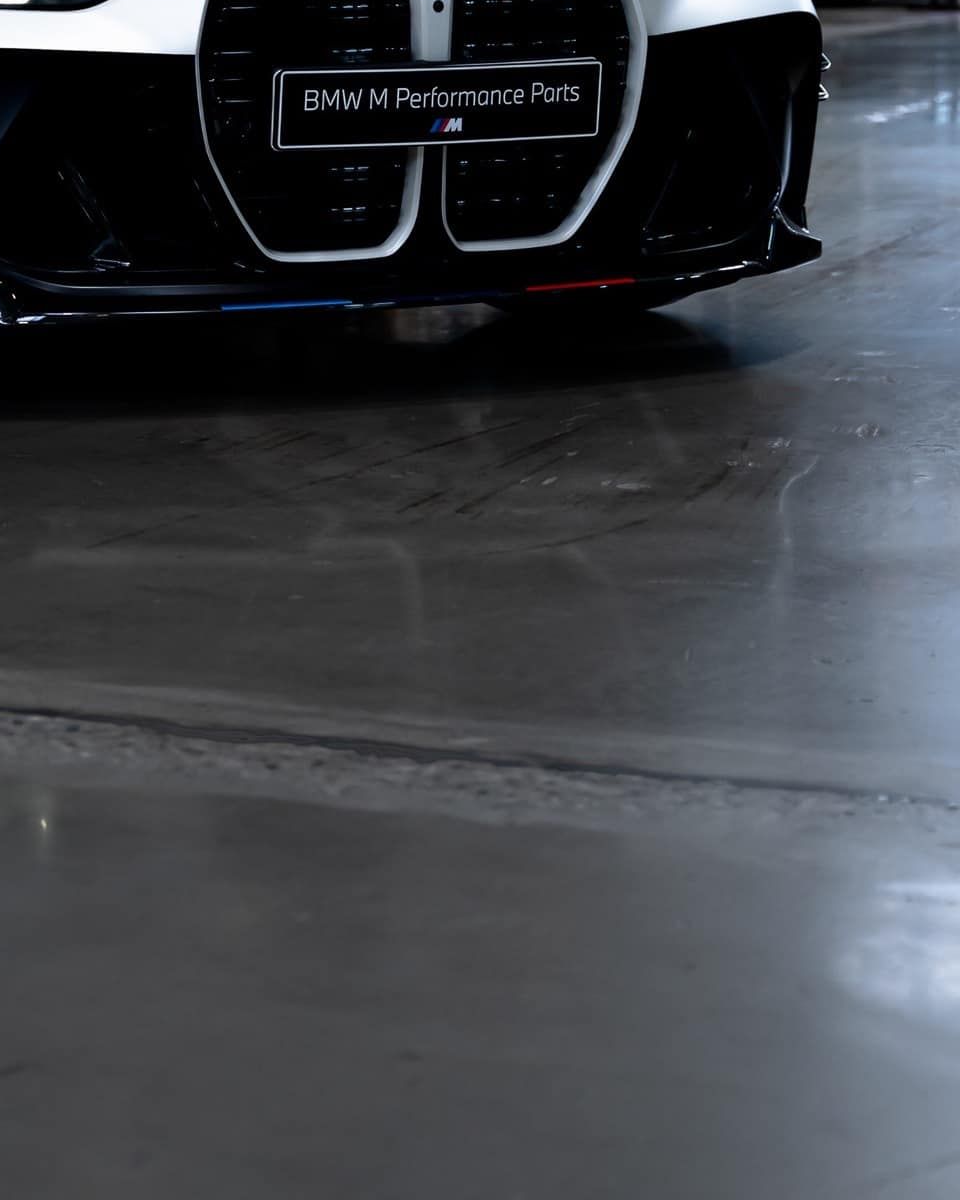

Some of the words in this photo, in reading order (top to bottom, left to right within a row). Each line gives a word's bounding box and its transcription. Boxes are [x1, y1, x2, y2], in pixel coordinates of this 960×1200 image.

[304, 89, 362, 111] BMW
[369, 88, 388, 109] M
[396, 86, 525, 109] Performance
[531, 82, 581, 104] Parts
[443, 117, 463, 132] M
